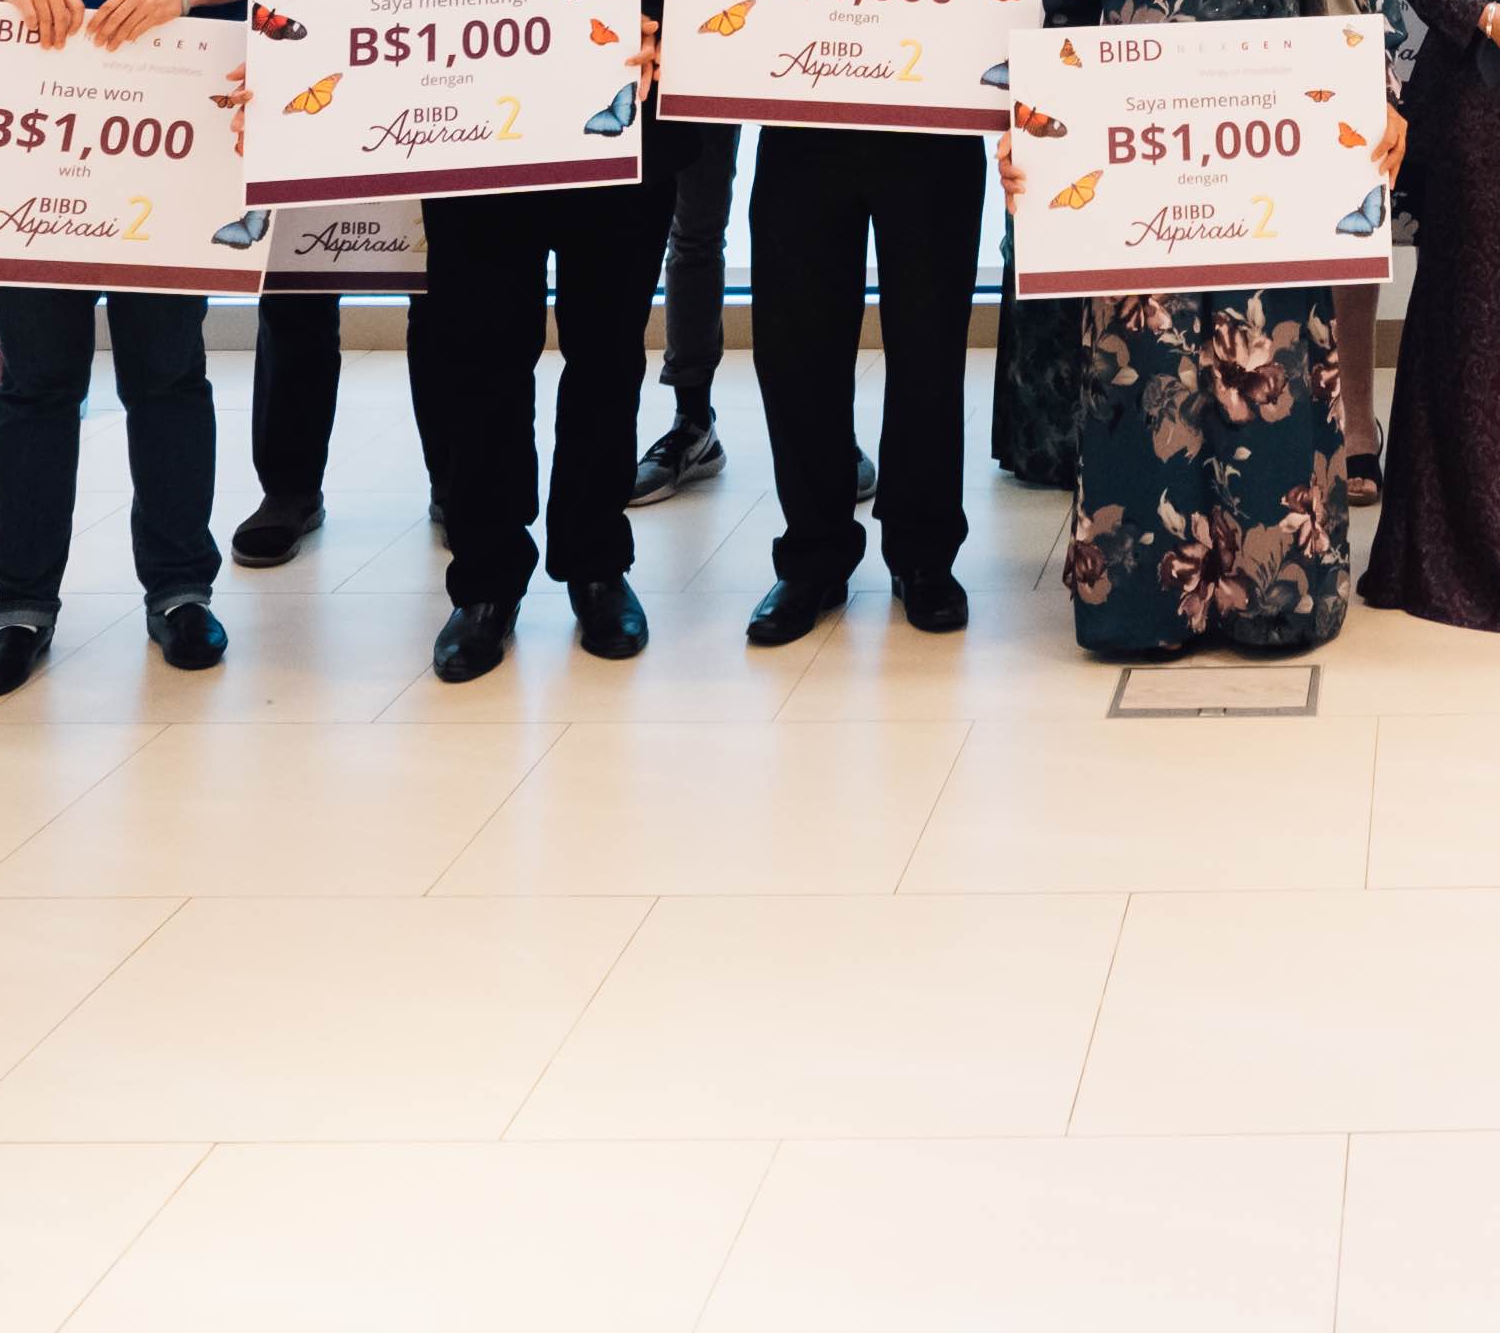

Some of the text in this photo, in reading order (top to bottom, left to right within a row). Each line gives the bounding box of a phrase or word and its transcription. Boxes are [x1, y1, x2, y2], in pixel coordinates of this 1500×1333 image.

[829, 10, 879, 26] dengan
[349, 16, 551, 67] B$1,000
[821, 41, 862, 57] BIBD
[1100, 39, 1163, 63] BIBD
[770, 39, 923, 88] Aspirasi 2
[38, 80, 144, 103] I have won
[420, 73, 474, 89] dengan
[413, 105, 458, 123] BIBD
[1126, 93, 1277, 115] Saya memenangi
[361, 94, 524, 159] Aspirasi 2
[1107, 118, 1301, 166] B$1,000
[58, 165, 92, 178] with
[1177, 172, 1229, 188] dengan
[39, 197, 87, 215] BIBD
[1172, 204, 1215, 220] BIBD
[121, 196, 154, 241] 2
[341, 222, 381, 235] BIBD
[1124, 194, 1279, 254] Aspirasi 2
[294, 222, 410, 262] Aspirasi
